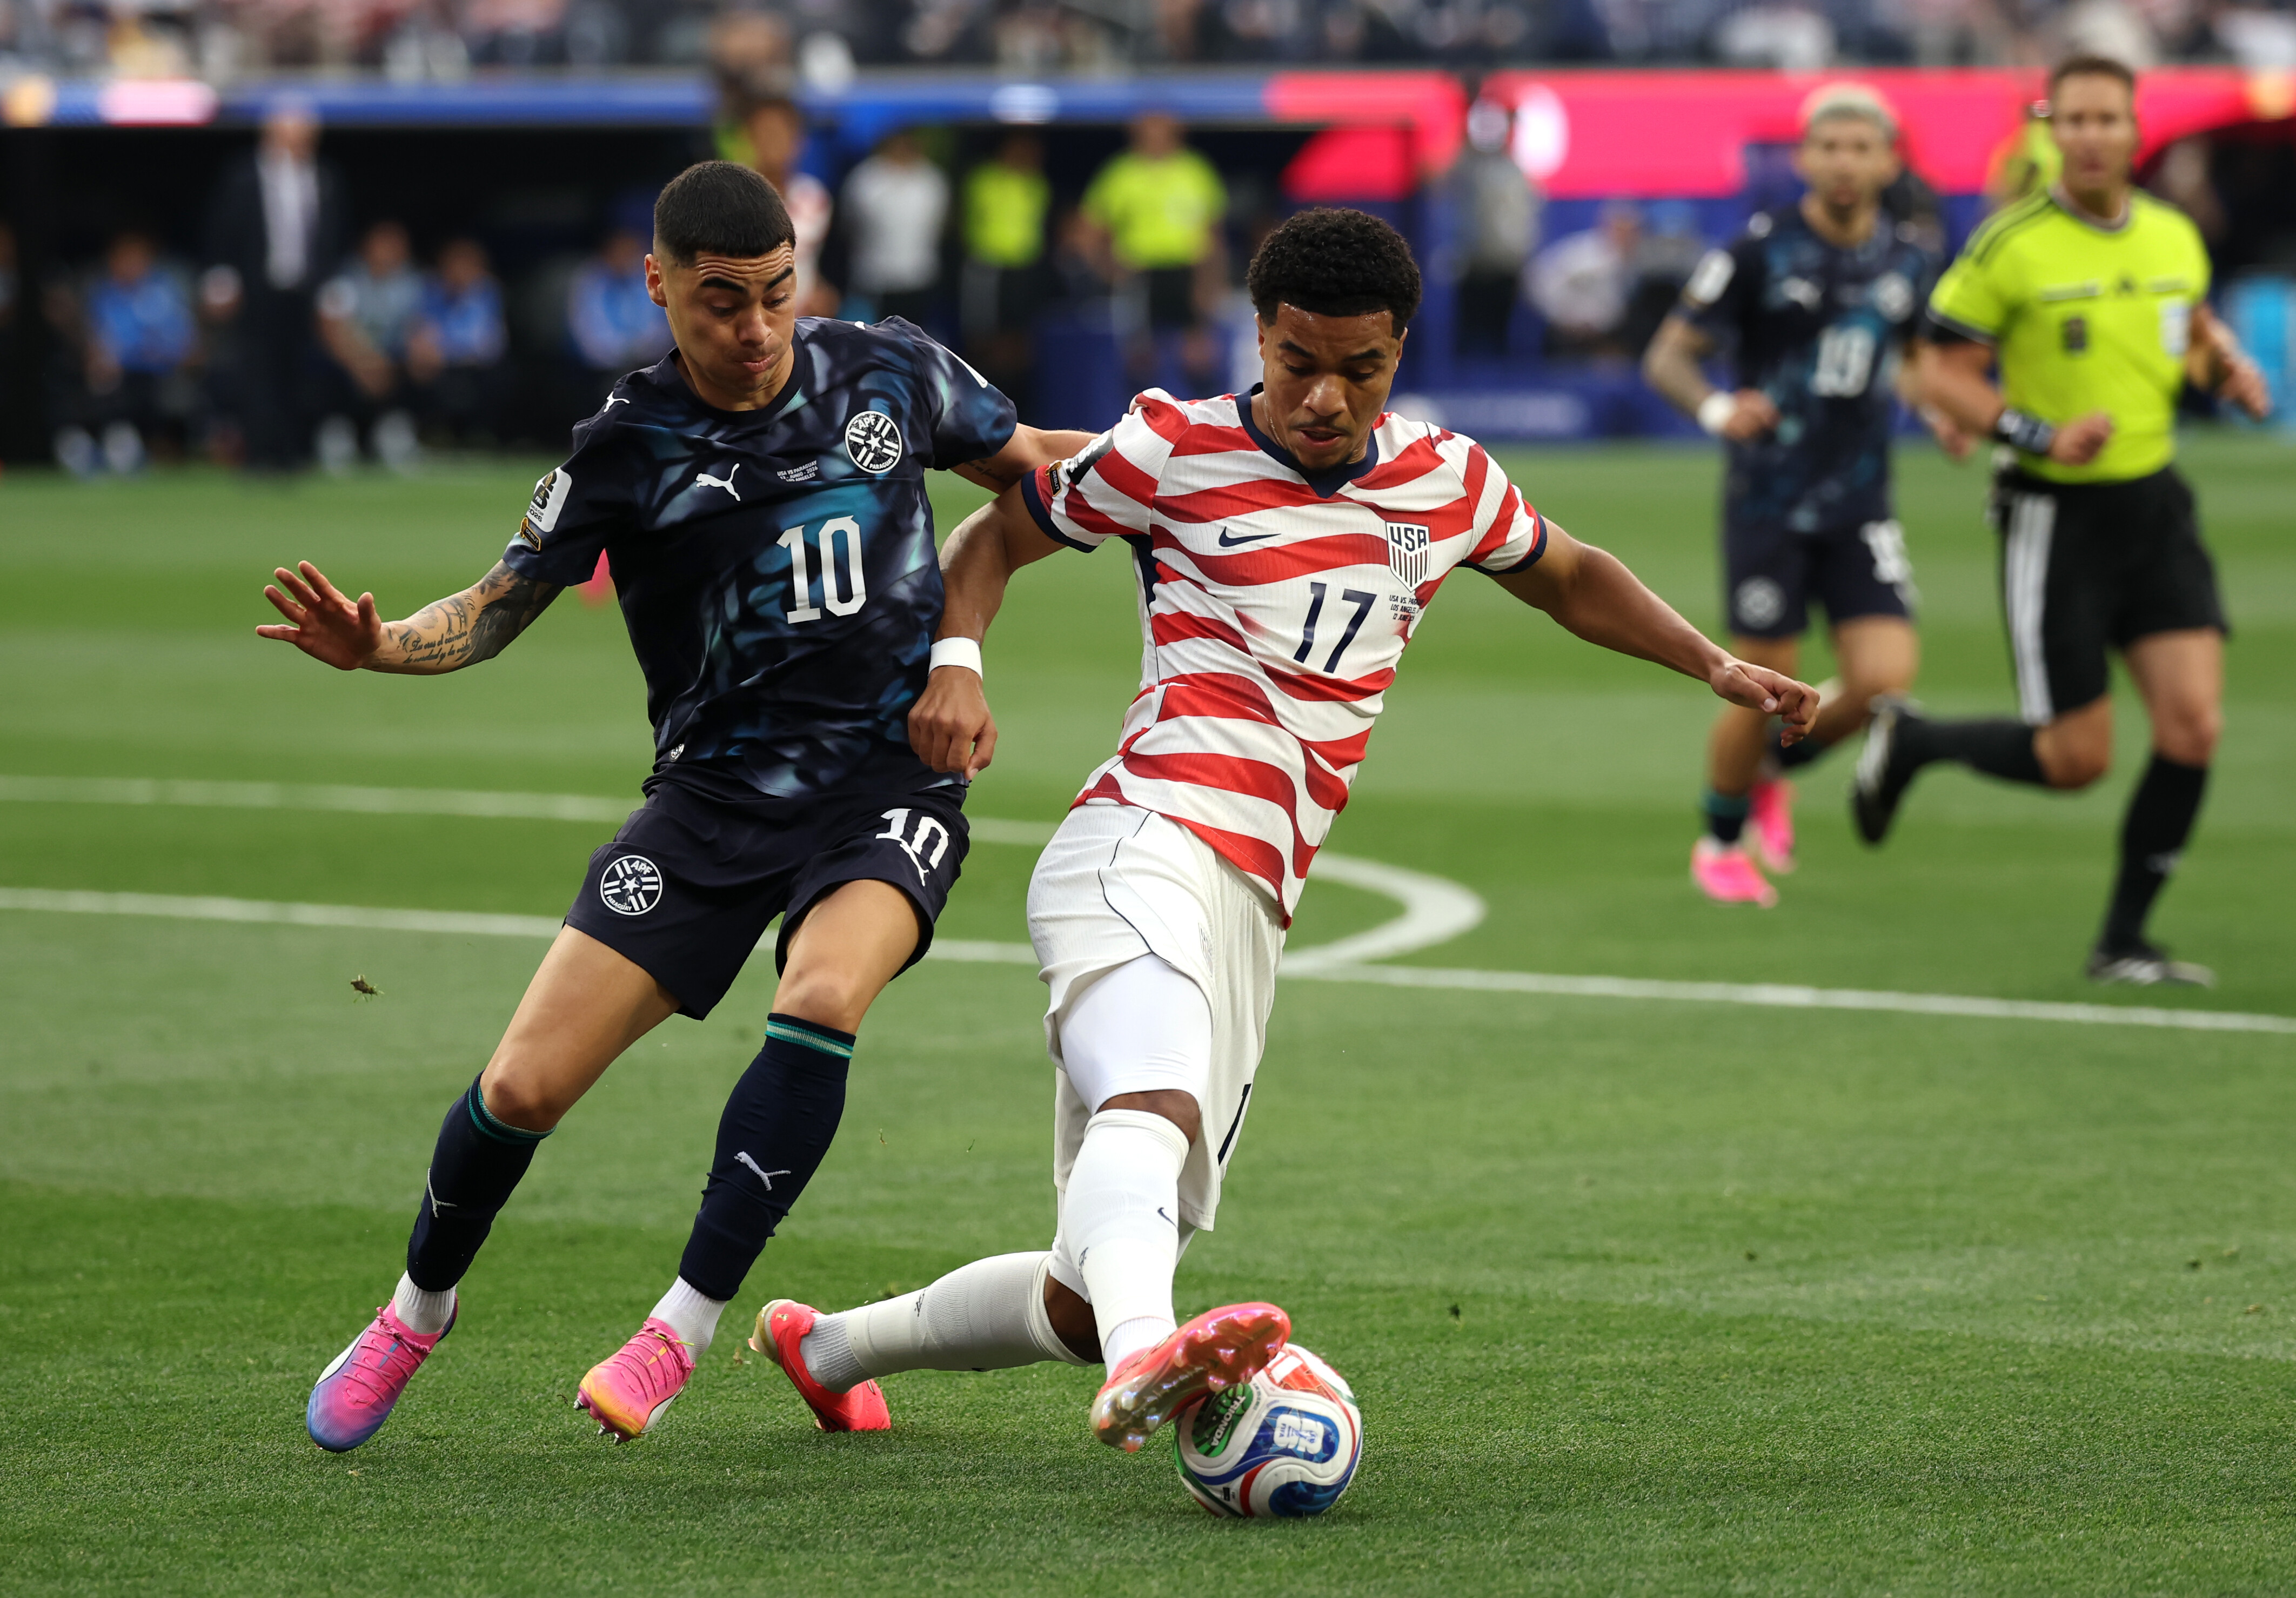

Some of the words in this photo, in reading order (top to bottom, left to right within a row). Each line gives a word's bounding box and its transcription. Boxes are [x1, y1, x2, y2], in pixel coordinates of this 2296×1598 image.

[858, 414, 875, 430] APF
[793, 460, 817, 473] PARAGUAY
[806, 466, 818, 474] 2026
[869, 457, 894, 470] PARAGUAY
[795, 472, 816, 482] ANGELES
[534, 496, 543, 505] FIFA
[525, 528, 539, 544] DEBUT
[1390, 526, 1427, 552] USA
[776, 515, 867, 624] 10
[1293, 581, 1377, 673] 17
[875, 808, 949, 870] 10
[630, 860, 653, 875] APF
[606, 895, 632, 912] PARAGUAY
[1211, 1395, 1246, 1446] TRIONDA
